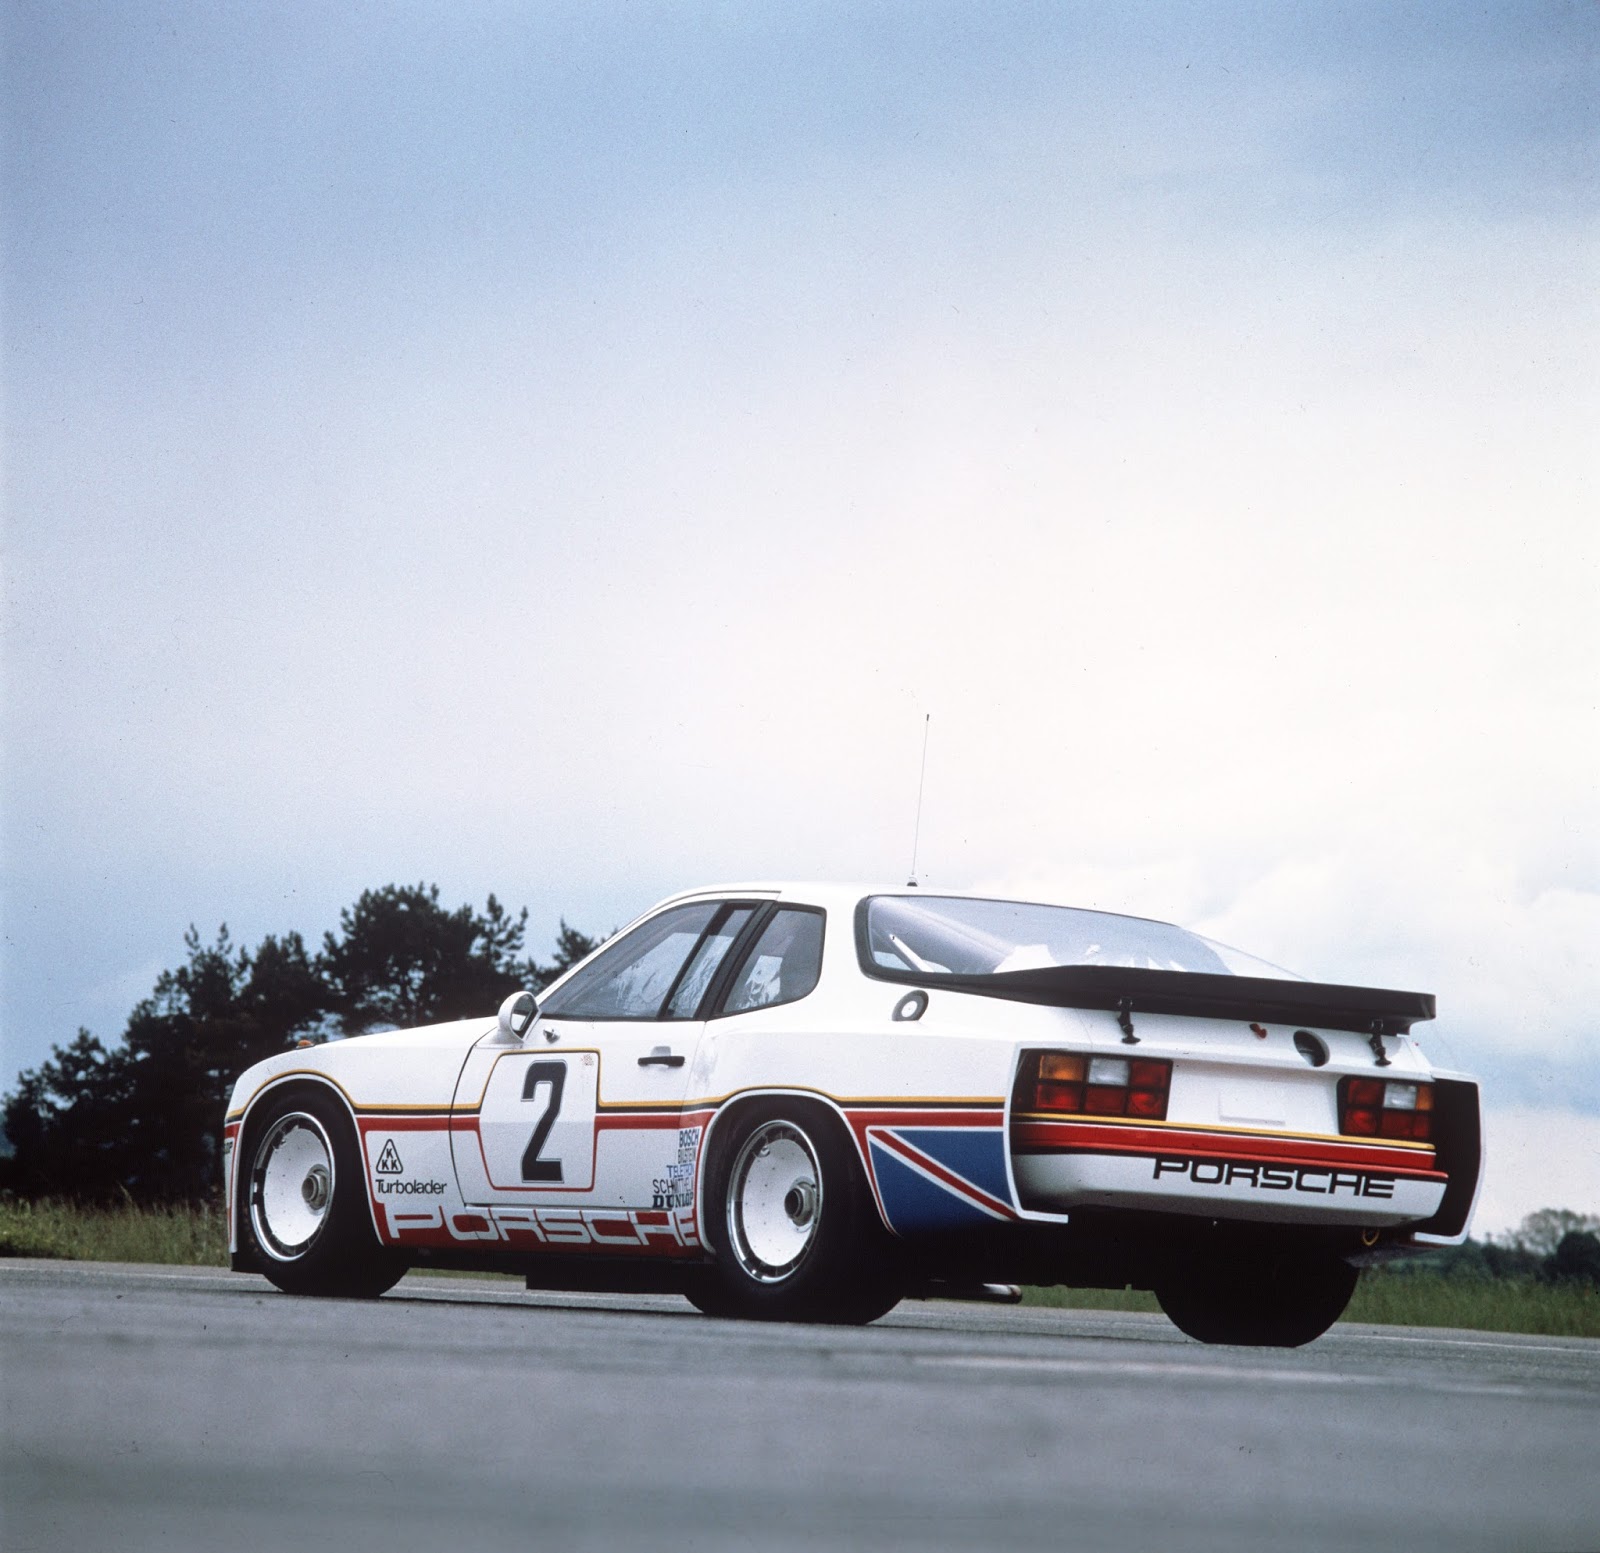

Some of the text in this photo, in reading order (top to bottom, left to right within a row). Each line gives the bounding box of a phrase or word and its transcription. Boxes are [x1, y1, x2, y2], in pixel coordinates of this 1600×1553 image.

[520, 1059, 568, 1184] 2
[679, 1128, 699, 1148] BOSCH
[375, 1179, 447, 1194] Turbolader
[1153, 1158, 1395, 1199] PORSCHE
[652, 1191, 694, 1208] DUNLOP
[384, 1203, 699, 1246] PORSCHE
